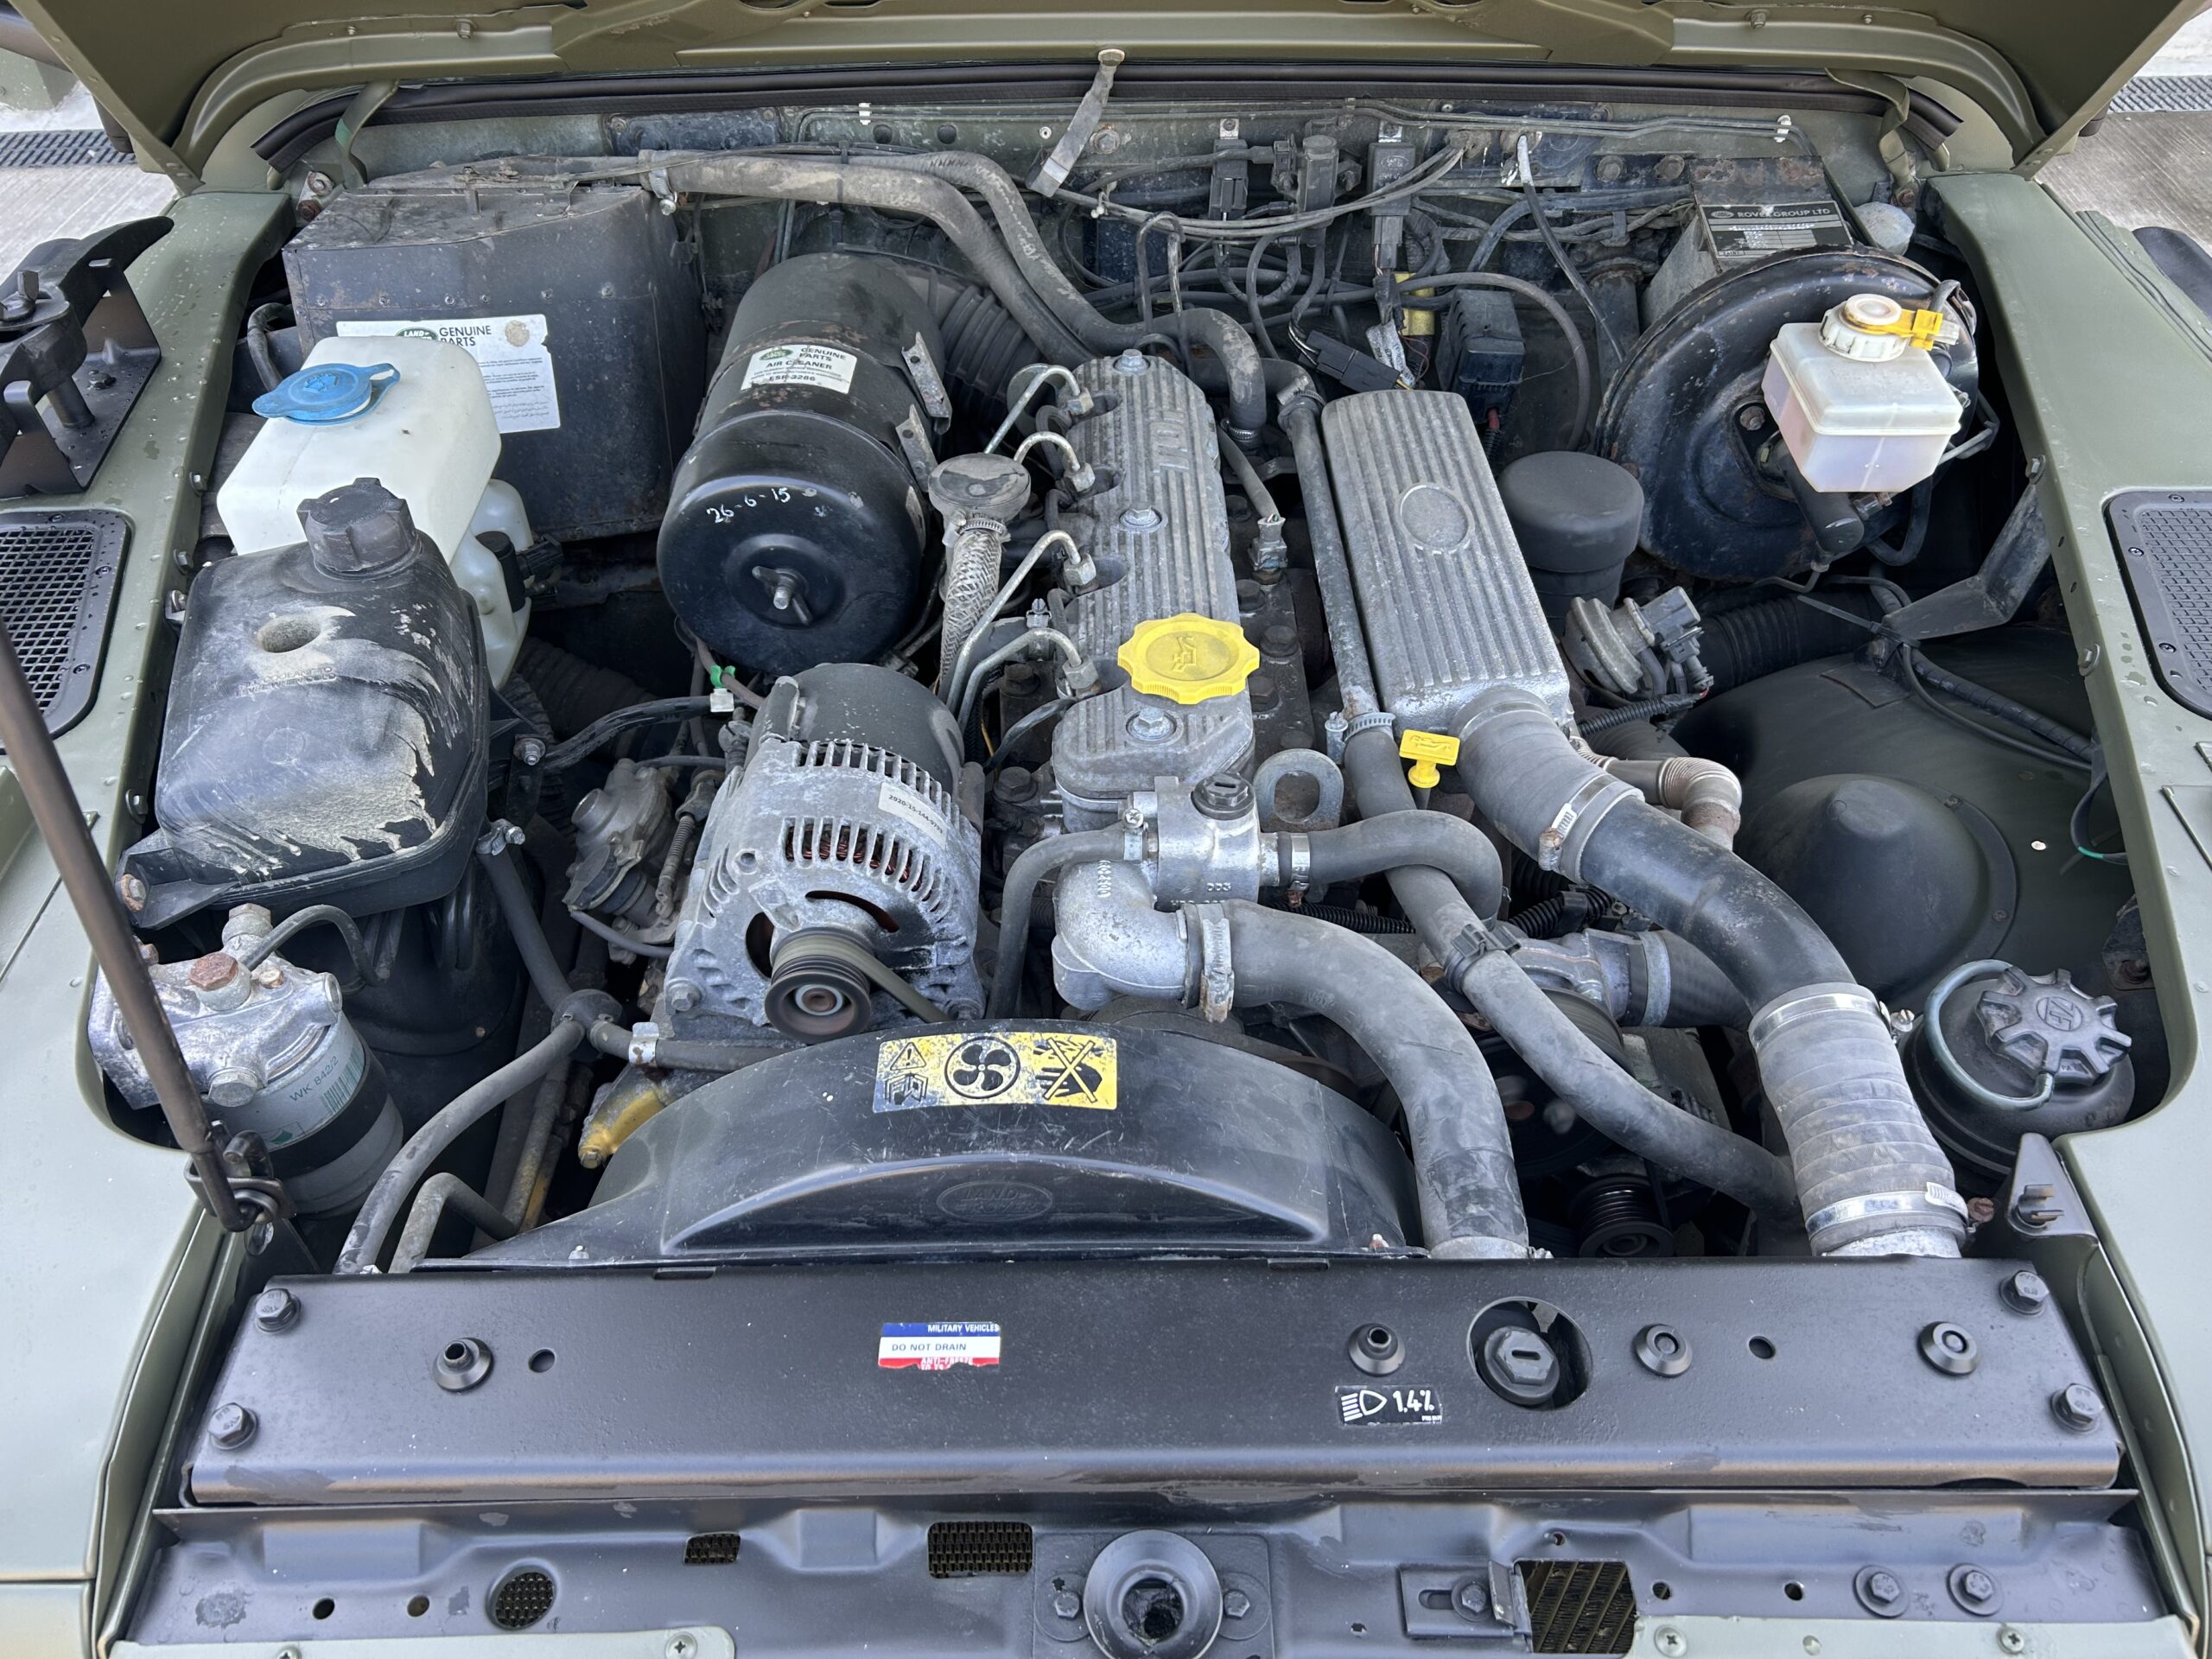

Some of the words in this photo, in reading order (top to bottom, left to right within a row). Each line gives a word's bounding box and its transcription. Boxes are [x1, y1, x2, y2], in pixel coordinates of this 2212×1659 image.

[439, 325, 492, 337] GENUINE
[798, 353, 832, 362] PARTS
[800, 347, 847, 360] GENUINE
[289, 1083, 313, 1101] WK
[314, 1056, 339, 1085] 842/2
[961, 1187, 1019, 1200] LAND
[927, 1323, 963, 1333] MILITARY
[964, 1323, 1000, 1332] VEHICLES
[1392, 1389, 1435, 1413] 1.4%
